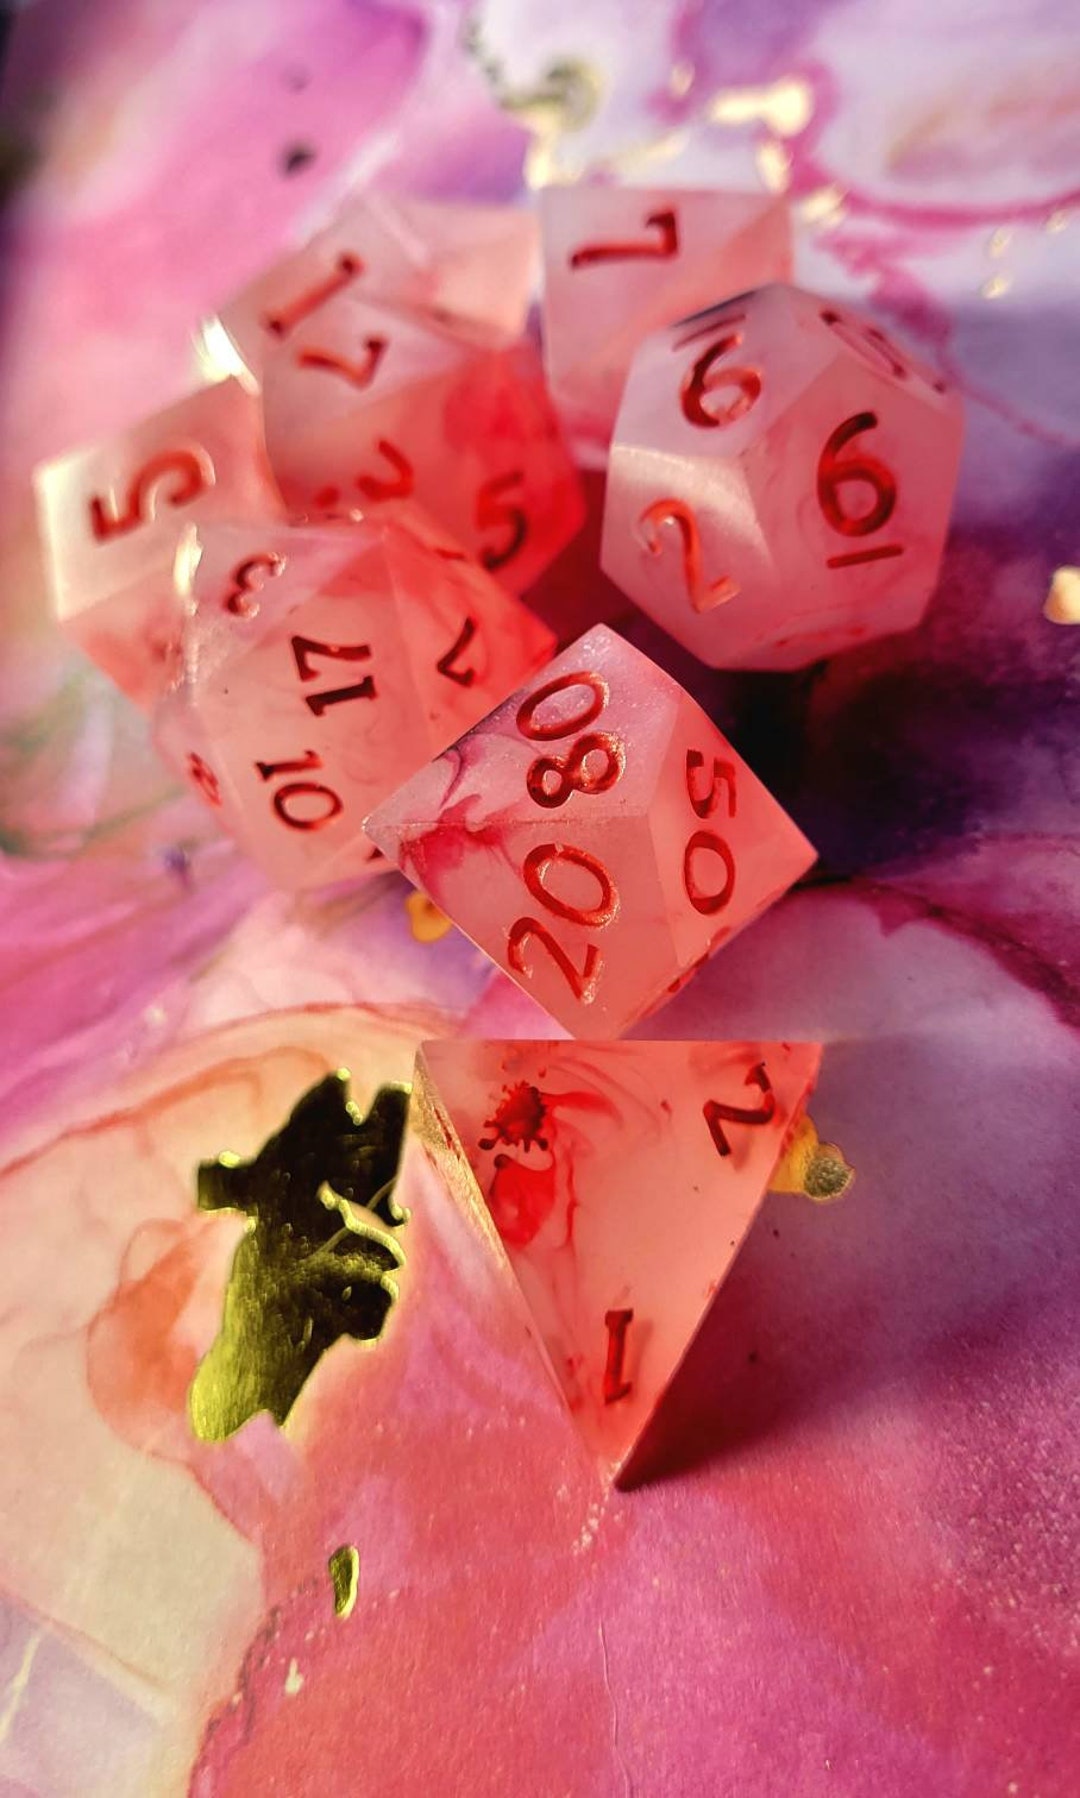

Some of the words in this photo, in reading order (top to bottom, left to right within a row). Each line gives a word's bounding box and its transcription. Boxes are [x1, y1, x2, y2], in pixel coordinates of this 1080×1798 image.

[568, 206, 681, 270] 7
[296, 333, 390, 390] 7
[89, 446, 215, 543] 5
[475, 469, 528, 572] 5
[222, 550, 288, 619] 3
[636, 497, 743, 615] 2
[289, 632, 378, 718] 17
[435, 617, 477, 688] 7
[514, 669, 628, 809] 80
[253, 750, 344, 832] 10
[682, 748, 737, 916] 50
[506, 842, 622, 1005] 20
[602, 1307, 636, 1406] 1
